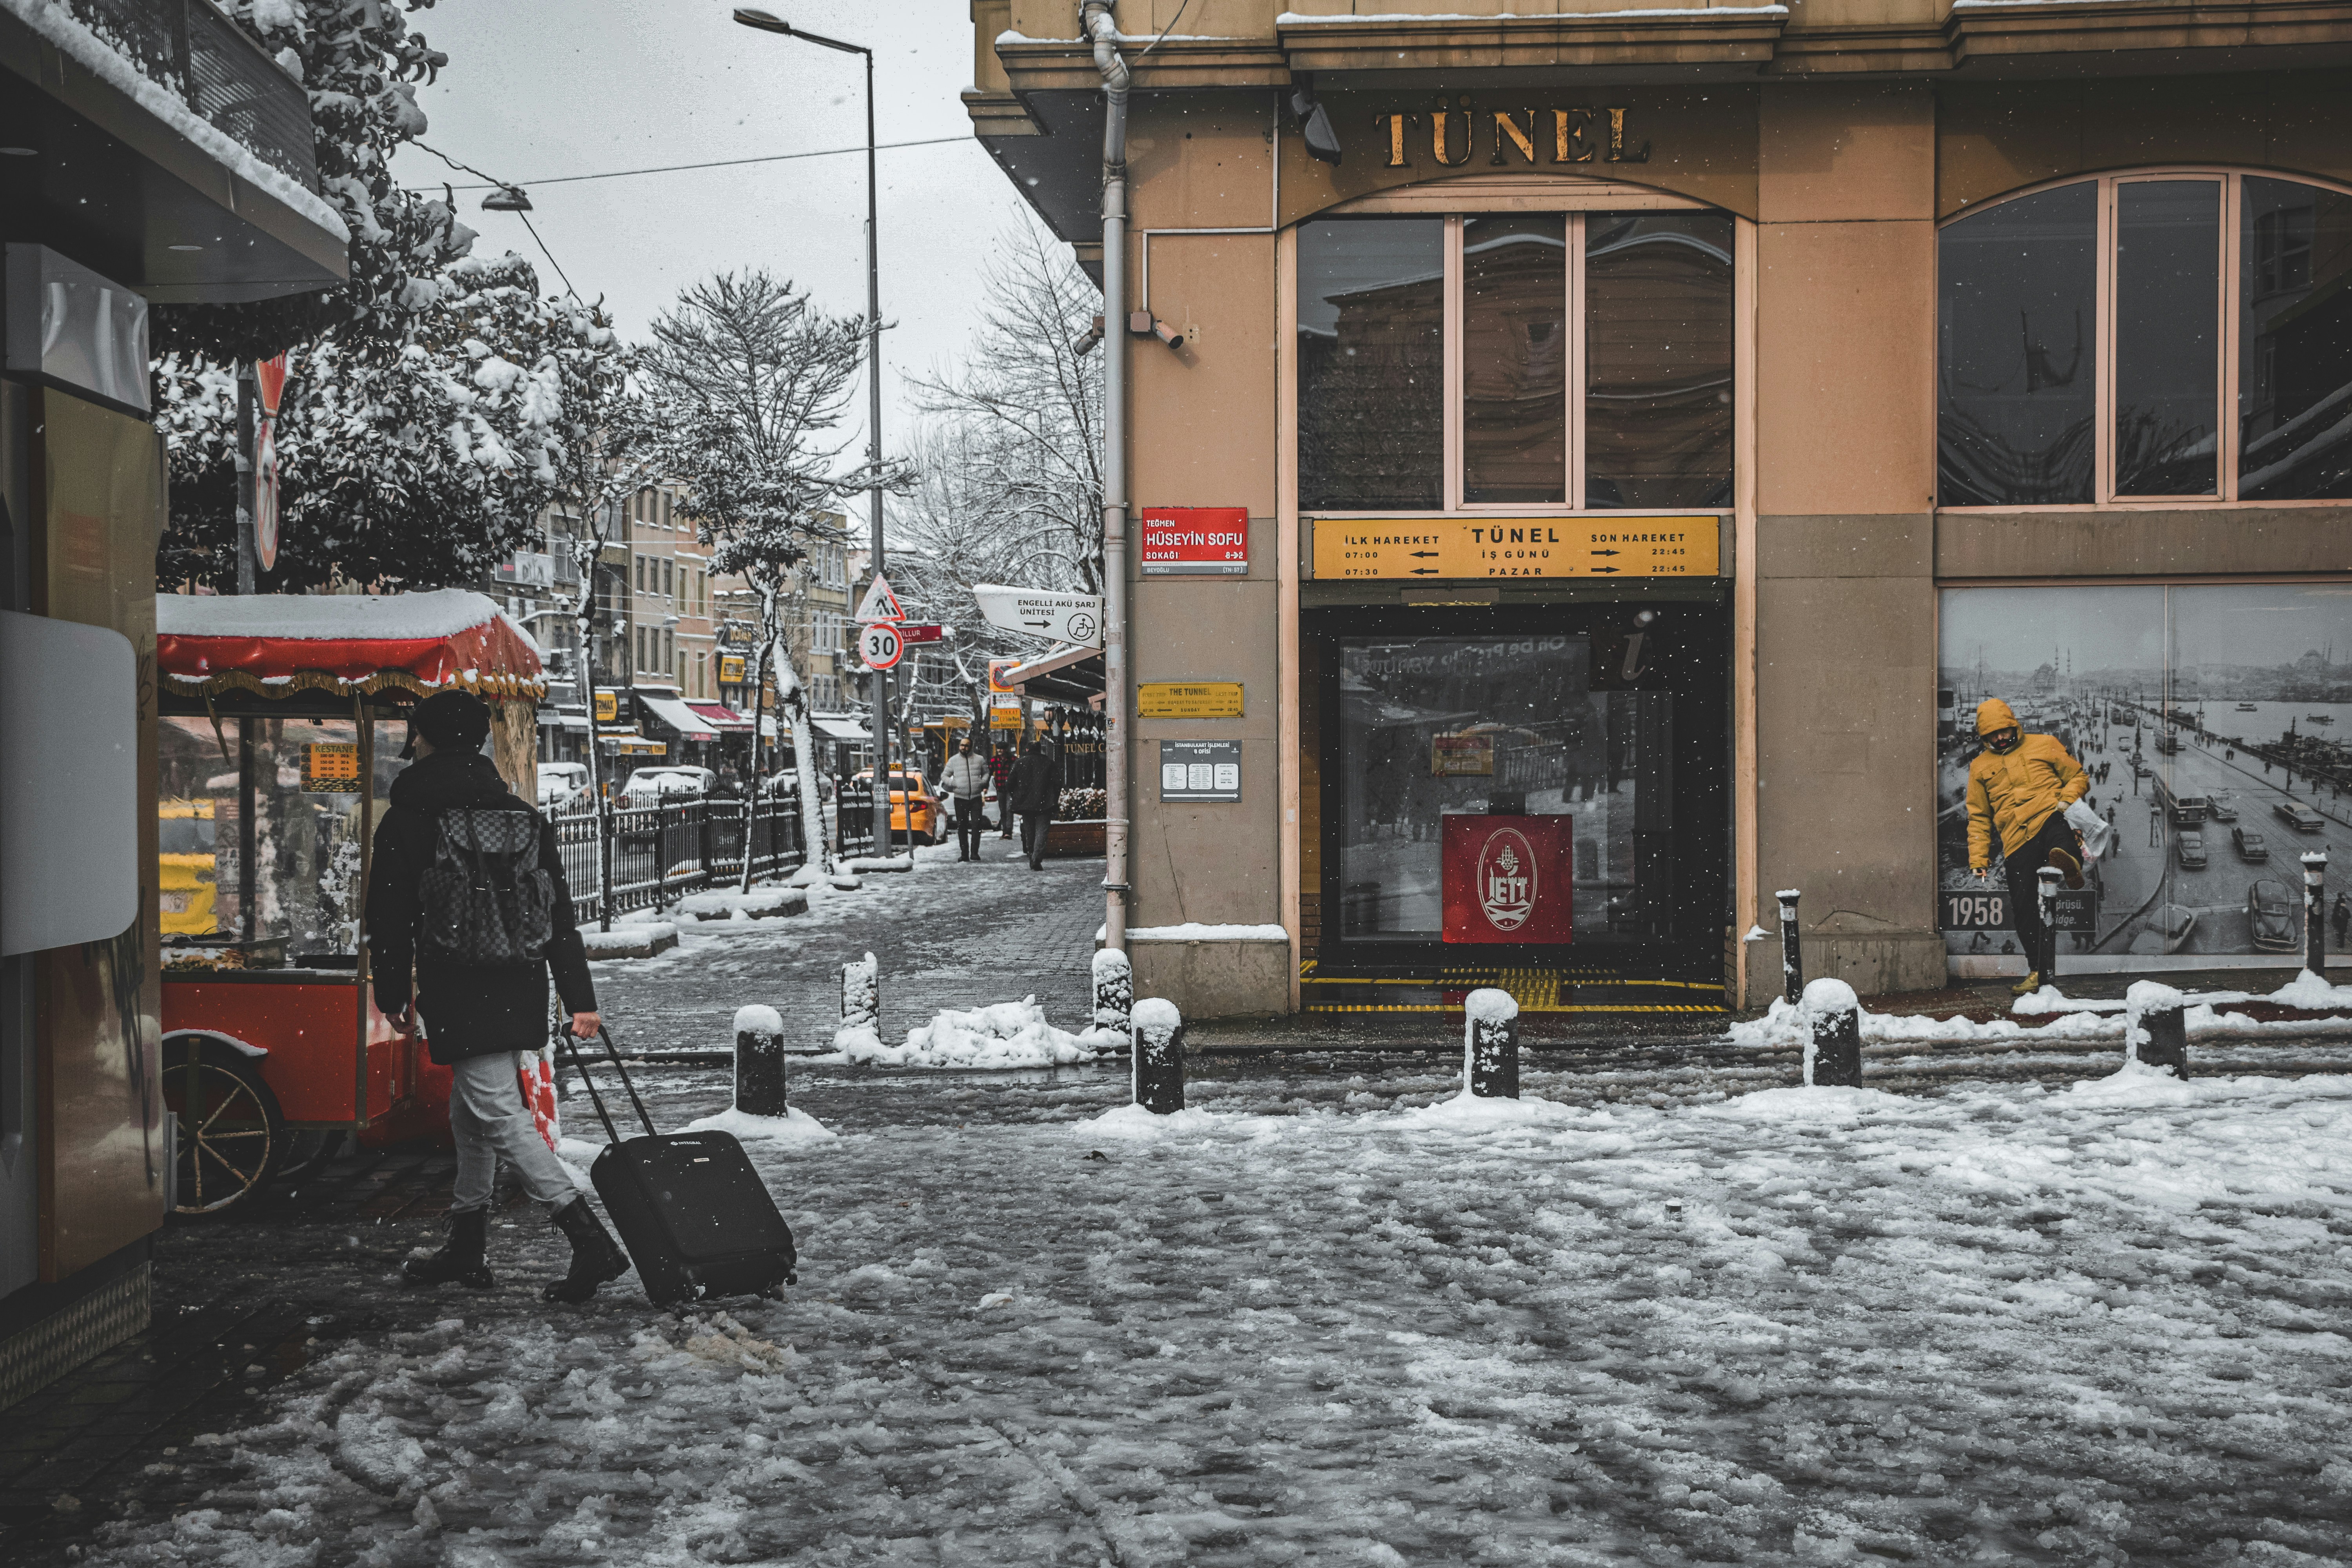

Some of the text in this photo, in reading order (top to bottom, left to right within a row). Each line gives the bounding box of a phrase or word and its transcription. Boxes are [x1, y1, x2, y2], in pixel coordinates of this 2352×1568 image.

[1375, 96, 1649, 166] TÜNEL
[1147, 531, 1243, 545] HÜSEYİN SOFU
[1345, 535, 1439, 544] İLK HAREKET
[1472, 526, 1559, 543] TÜNEL
[1591, 534, 1685, 543] SON HAREKET
[1505, 550, 1549, 559] GÜNÜ
[1020, 608, 1054, 616] ÜNİTESİ
[869, 636, 894, 656] 30
[1065, 741, 1096, 753] TÜNEL
[1949, 897, 2003, 926] 1958
